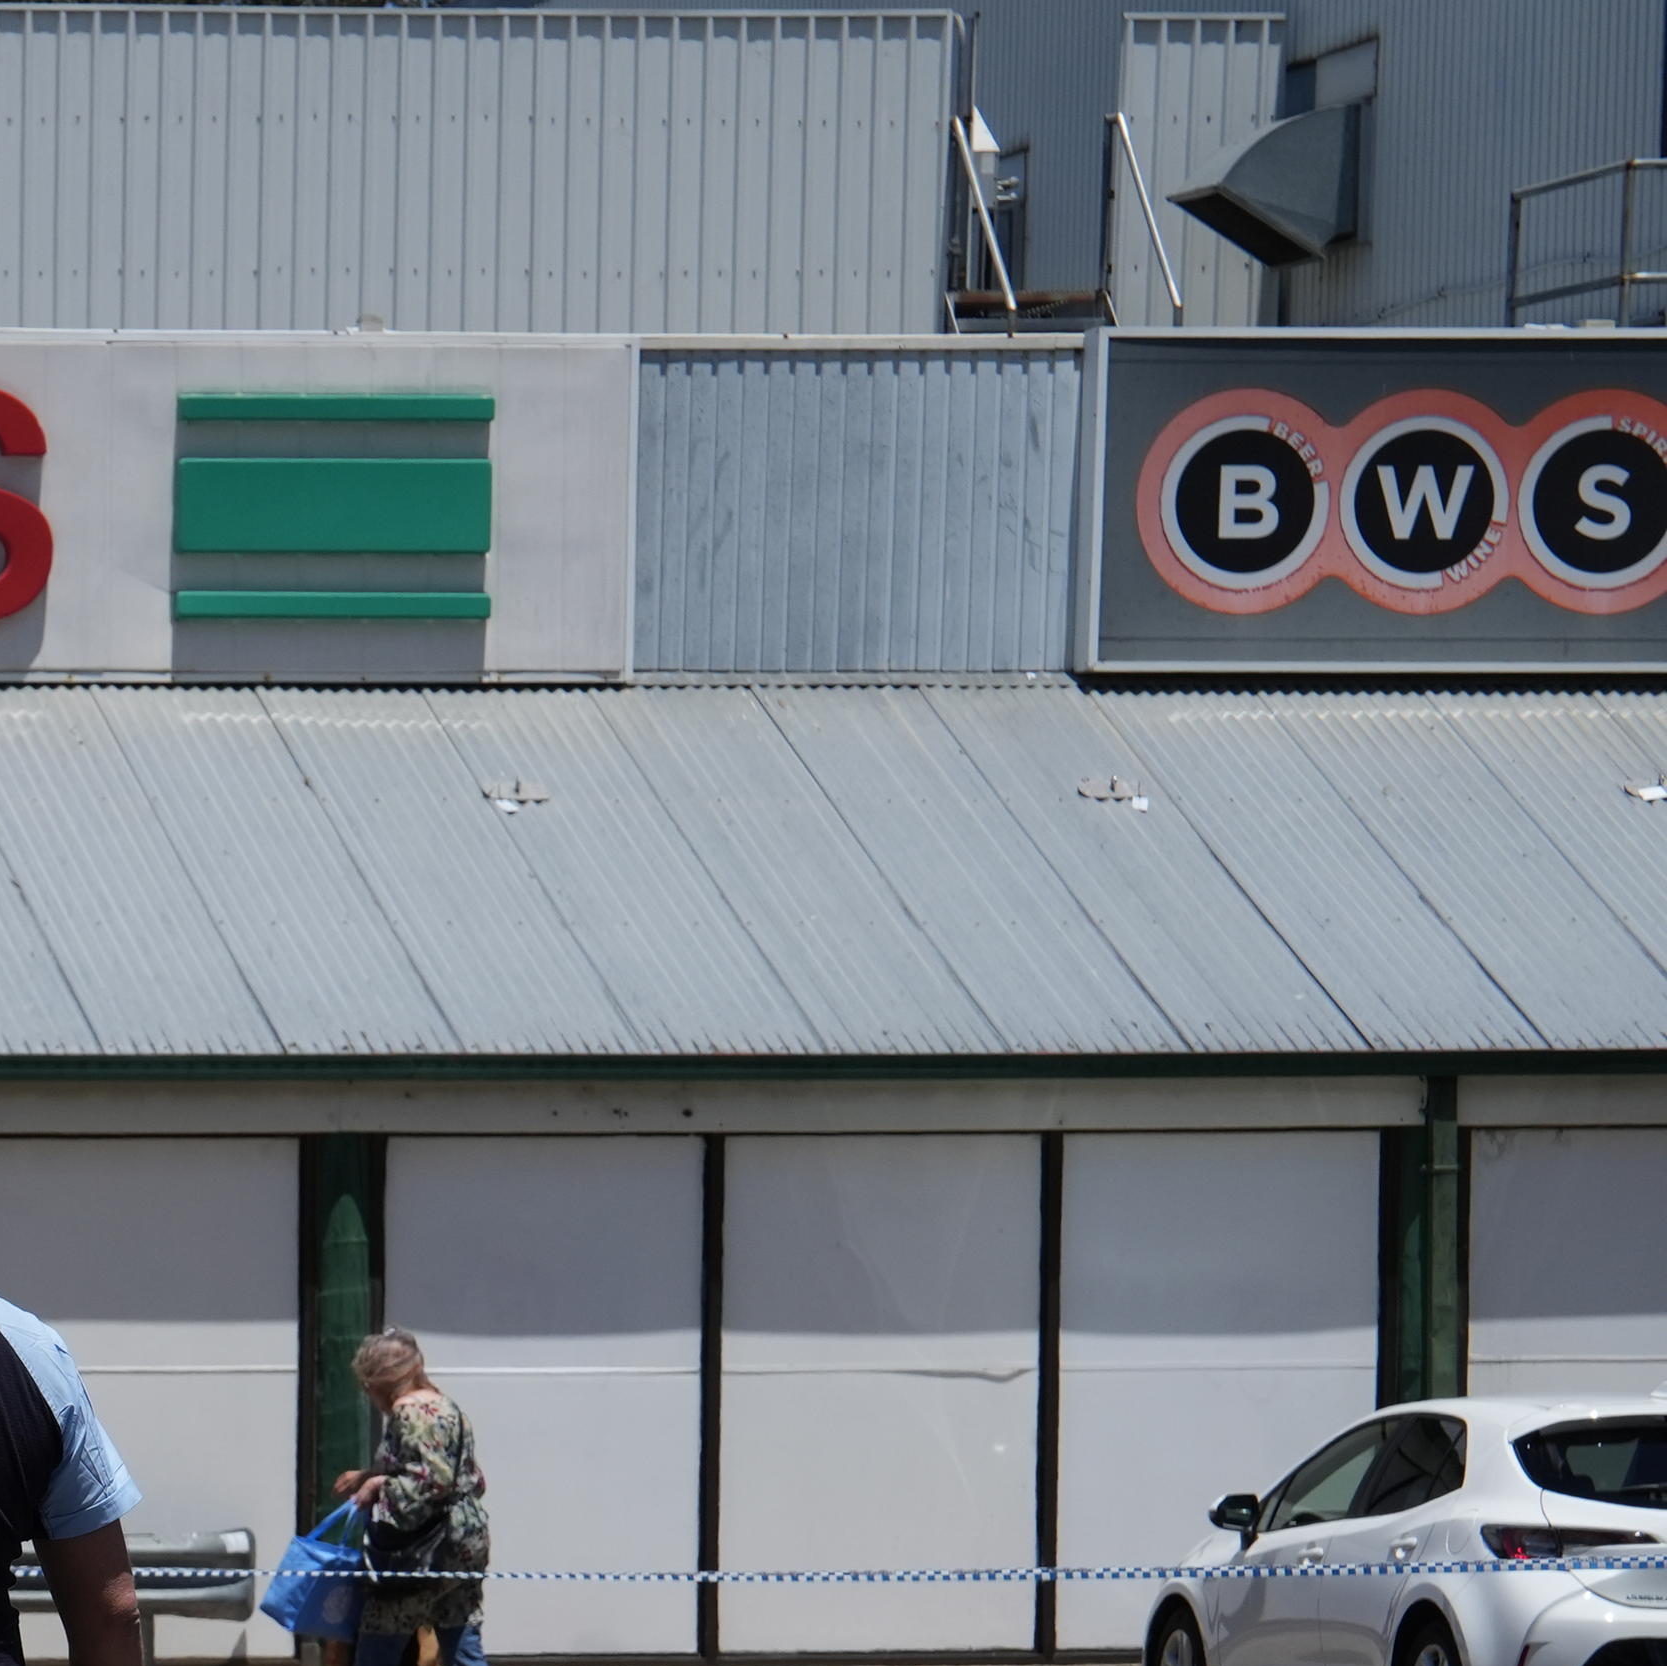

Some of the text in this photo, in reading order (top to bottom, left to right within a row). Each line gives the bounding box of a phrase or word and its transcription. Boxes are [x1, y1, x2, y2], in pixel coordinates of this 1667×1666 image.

[1272, 420, 1324, 478] BEER
[1617, 416, 1667, 464] SPIR
[1444, 526, 1502, 582] WINE
